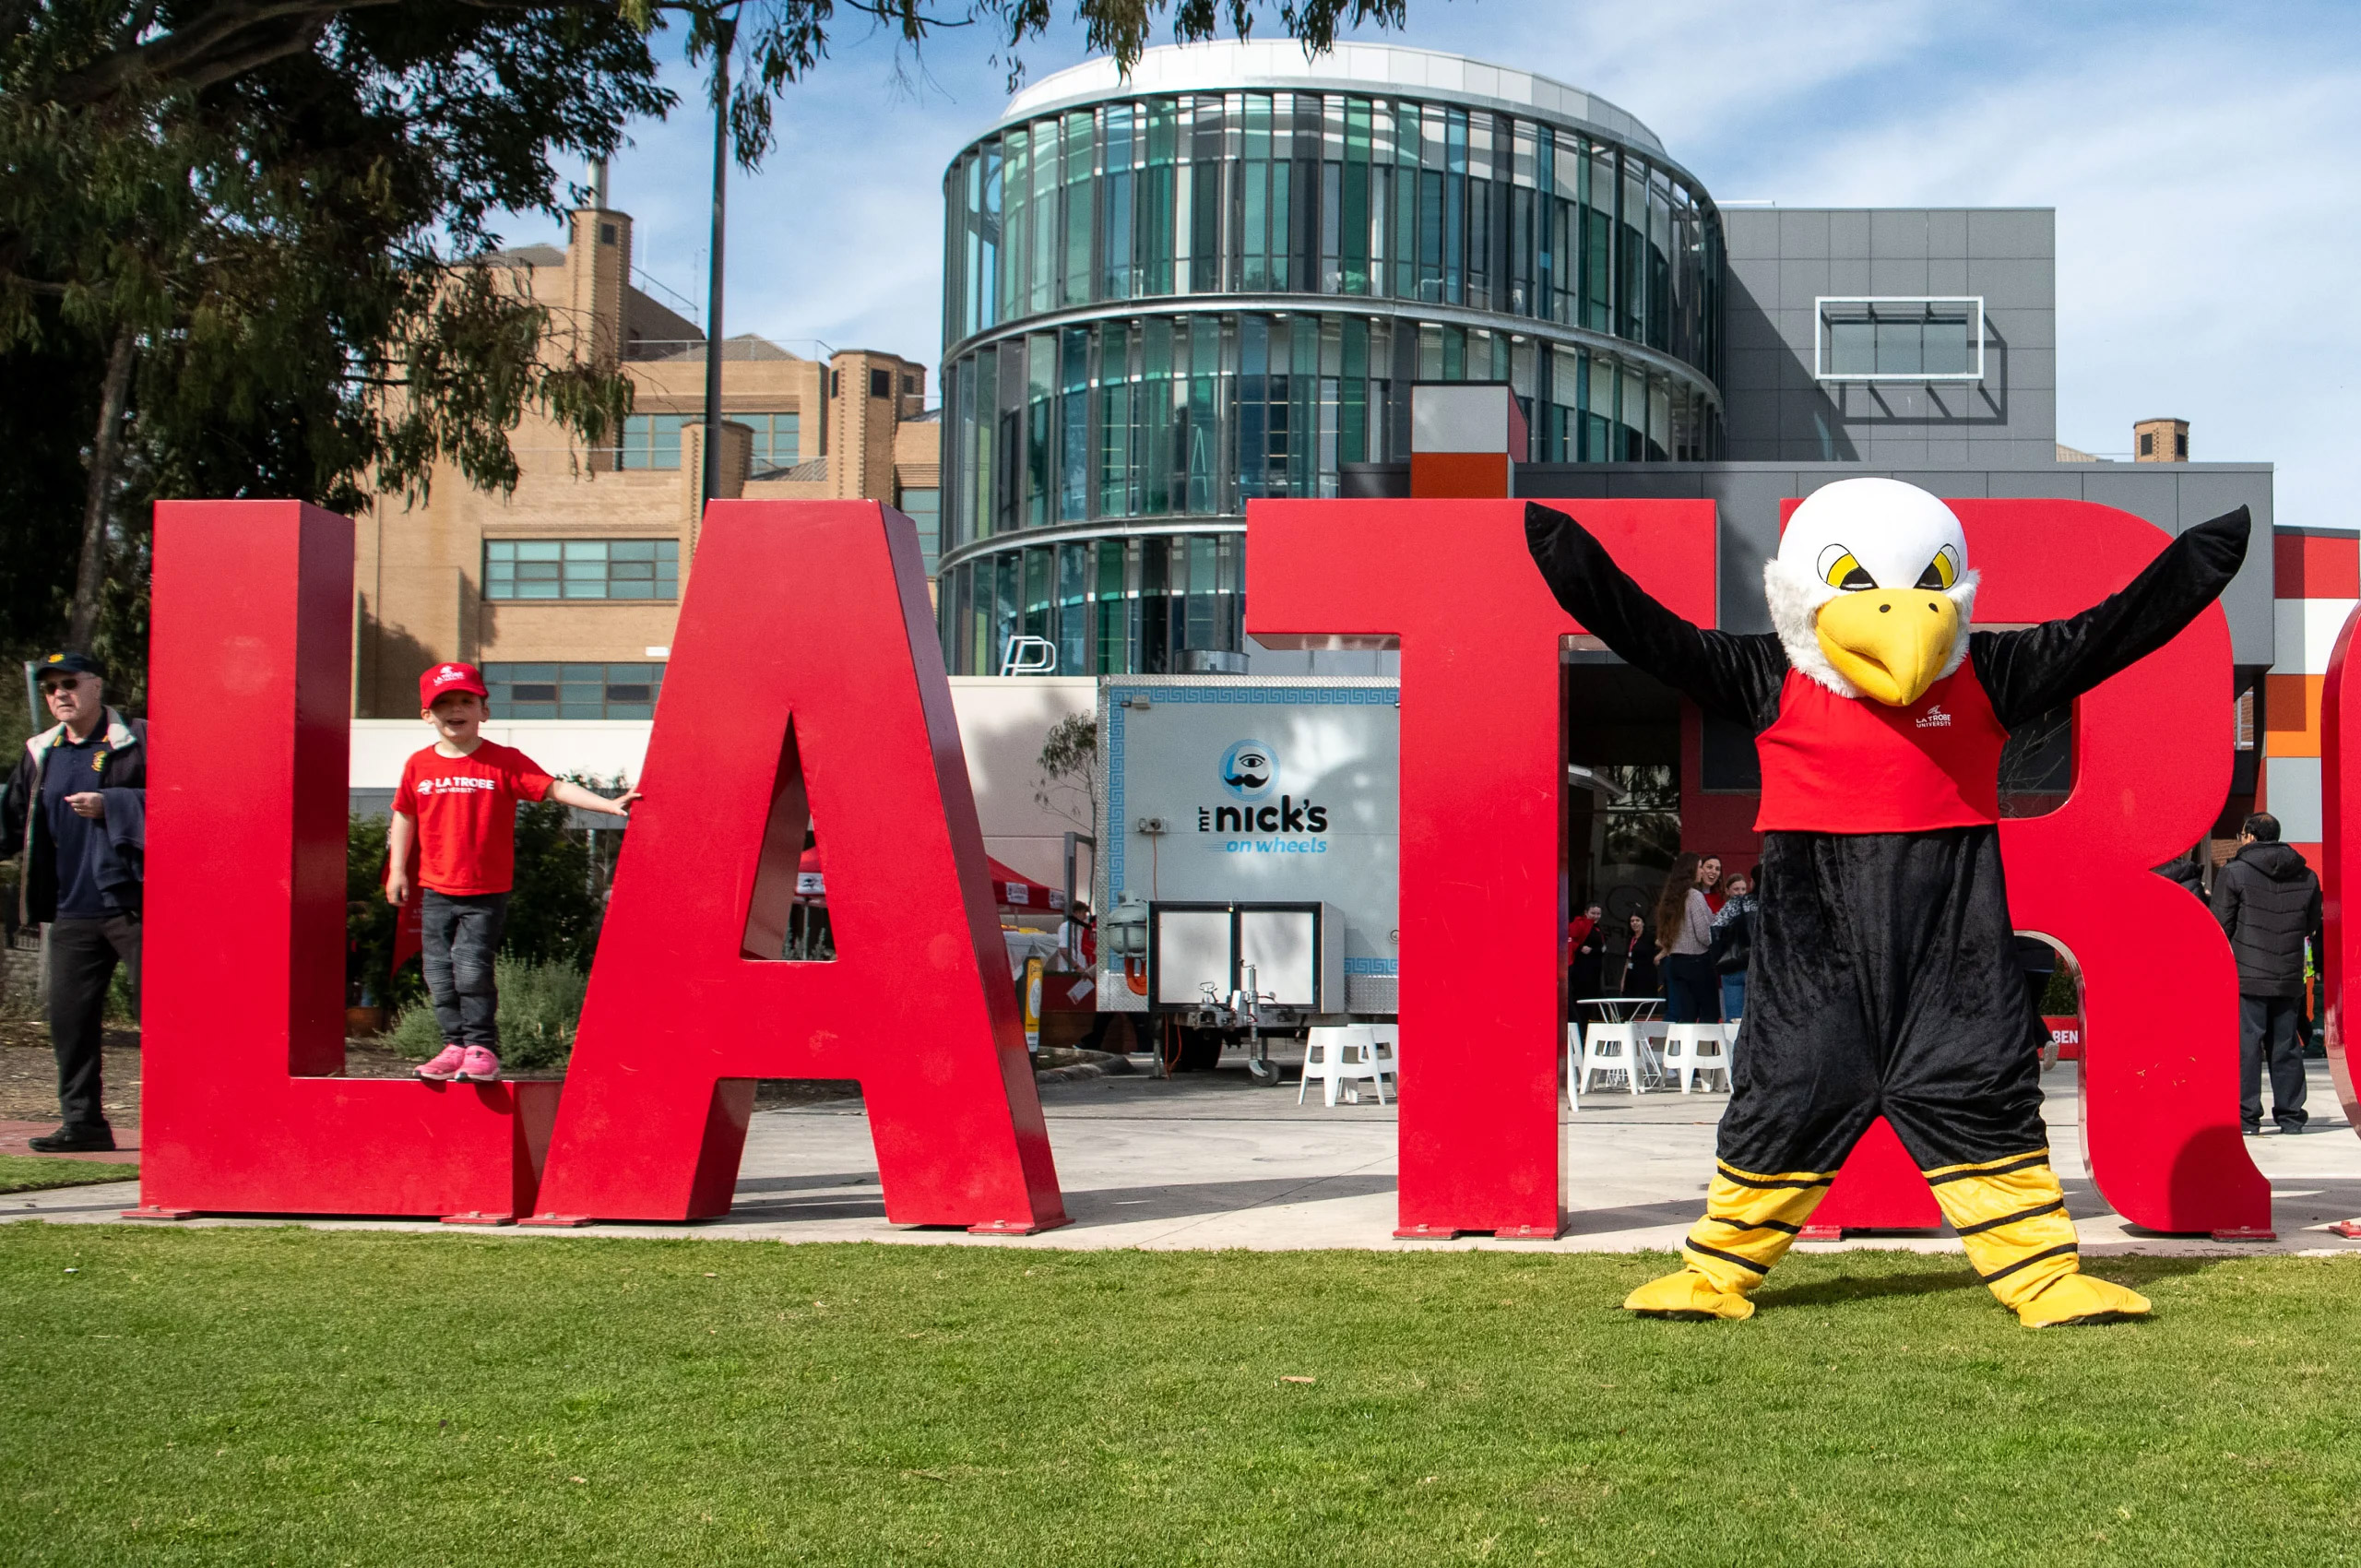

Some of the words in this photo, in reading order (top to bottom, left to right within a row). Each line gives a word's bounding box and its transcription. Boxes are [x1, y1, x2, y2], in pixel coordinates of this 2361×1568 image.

[434, 777, 452, 788] LA
[453, 776, 495, 790] TROBE
[1198, 806, 1210, 832] mr
[1216, 794, 1328, 833] nick's
[1226, 839, 1252, 853] on
[1255, 837, 1328, 853] wheels
[141, 498, 1062, 1227] LA
[1247, 498, 2361, 1236] TR
